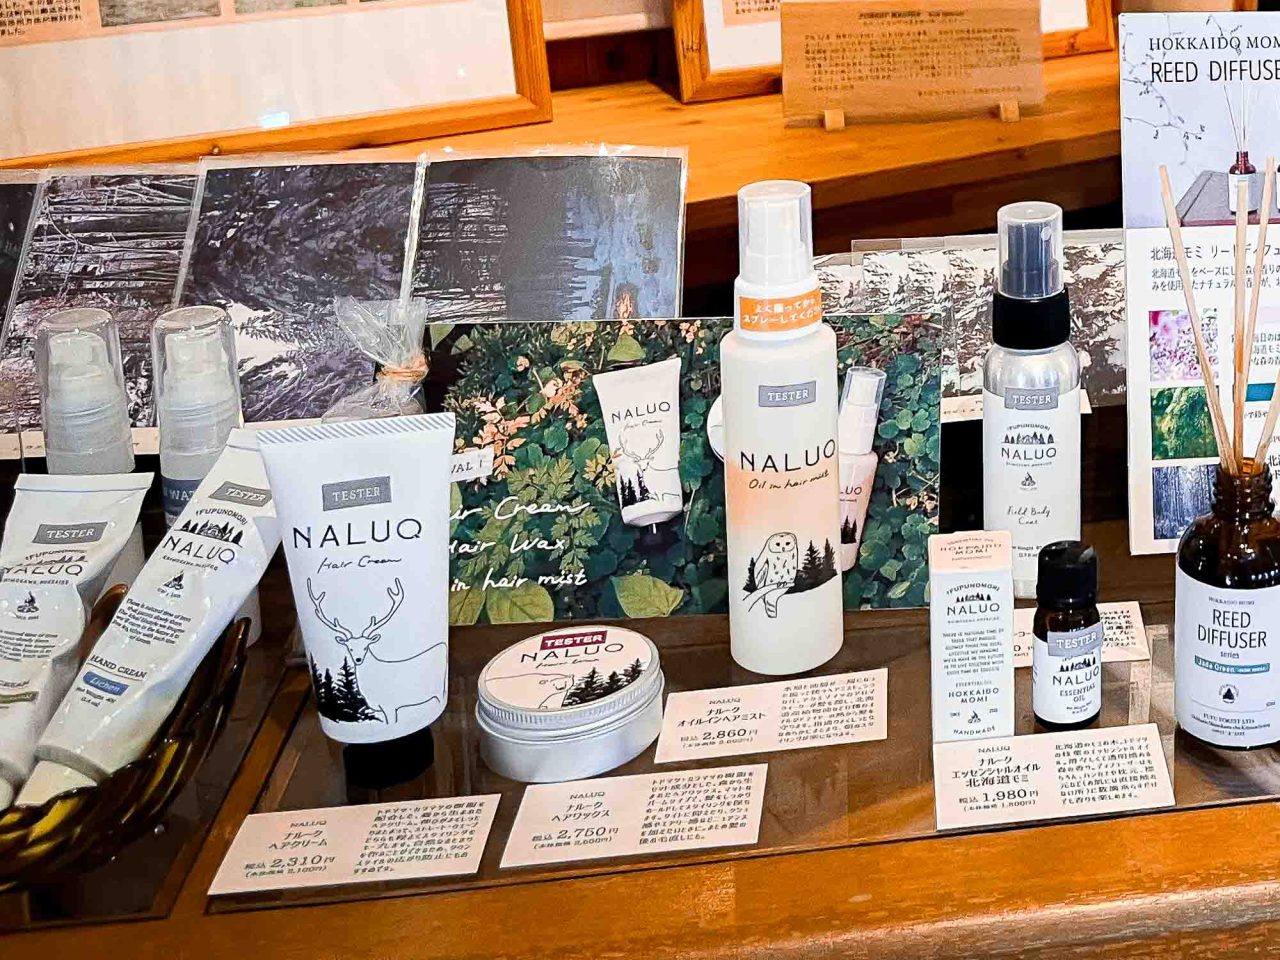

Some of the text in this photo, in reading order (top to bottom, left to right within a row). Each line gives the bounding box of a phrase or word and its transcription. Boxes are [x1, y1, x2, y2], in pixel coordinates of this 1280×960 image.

[1149, 35, 1241, 51] HOKKAIDO
[1151, 60, 1198, 83] REED
[768, 390, 809, 401] TESTER
[1013, 395, 1051, 404] TESTER
[748, 478, 765, 489] Oil
[784, 478, 807, 490] hair
[809, 470, 830, 484] mist
[225, 488, 266, 502] TESTER
[332, 486, 381, 503] TESTER
[495, 495, 591, 521] Cream
[47, 528, 95, 540] TESTER
[293, 518, 423, 550] NALUQ
[162, 535, 236, 565] NALUQ
[510, 533, 566, 554] Wax
[317, 555, 402, 574] Hair Cream
[451, 568, 588, 592] in hair mist
[1213, 608, 1251, 628] REED
[545, 634, 605, 647] TESTER
[1056, 631, 1097, 649] TESTER
[1198, 624, 1267, 649] DIFFUSER
[1220, 650, 1240, 659] series
[90, 654, 147, 679] HAND CREAM
[949, 688, 999, 698] HOKKAIDO
[1059, 683, 1096, 697] ESSENTIAL
[961, 696, 988, 704] MOMI
[706, 706, 740, 716] ナルーク
[678, 712, 767, 727] オイルインヘアミスト
[978, 756, 1012, 766] ナルーク
[952, 764, 1041, 779] エッセンシャルオイル
[965, 774, 1029, 787] 北海道モミ
[566, 802, 604, 811] ナルーク
[552, 810, 611, 822] ヘアワックス
[284, 829, 323, 840] ナルーク
[269, 839, 328, 850] ヘアクリーム
